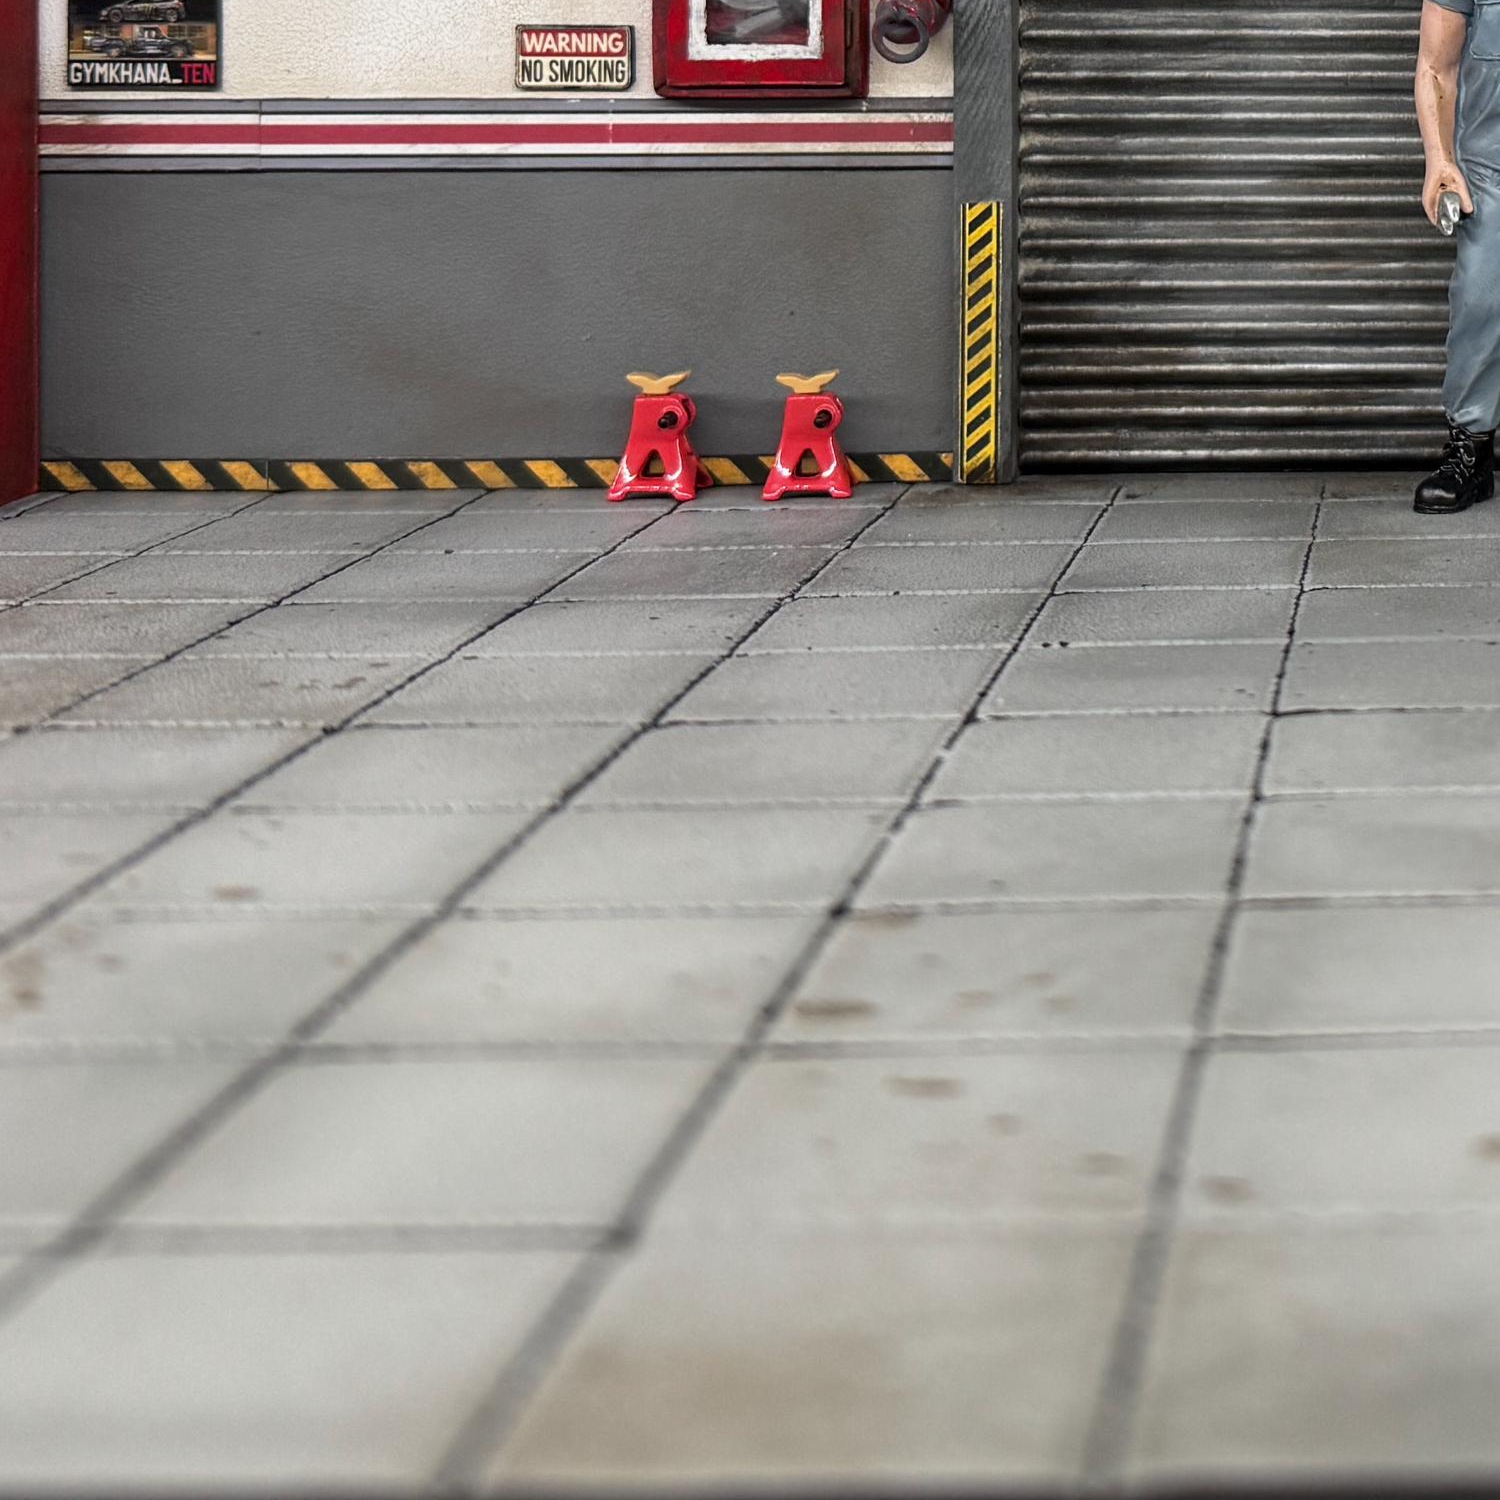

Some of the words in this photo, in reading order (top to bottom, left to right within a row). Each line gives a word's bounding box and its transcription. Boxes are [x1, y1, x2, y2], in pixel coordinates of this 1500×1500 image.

[522, 32, 624, 53] WARNING
[521, 59, 544, 82] NO
[549, 59, 626, 82] SMOKING
